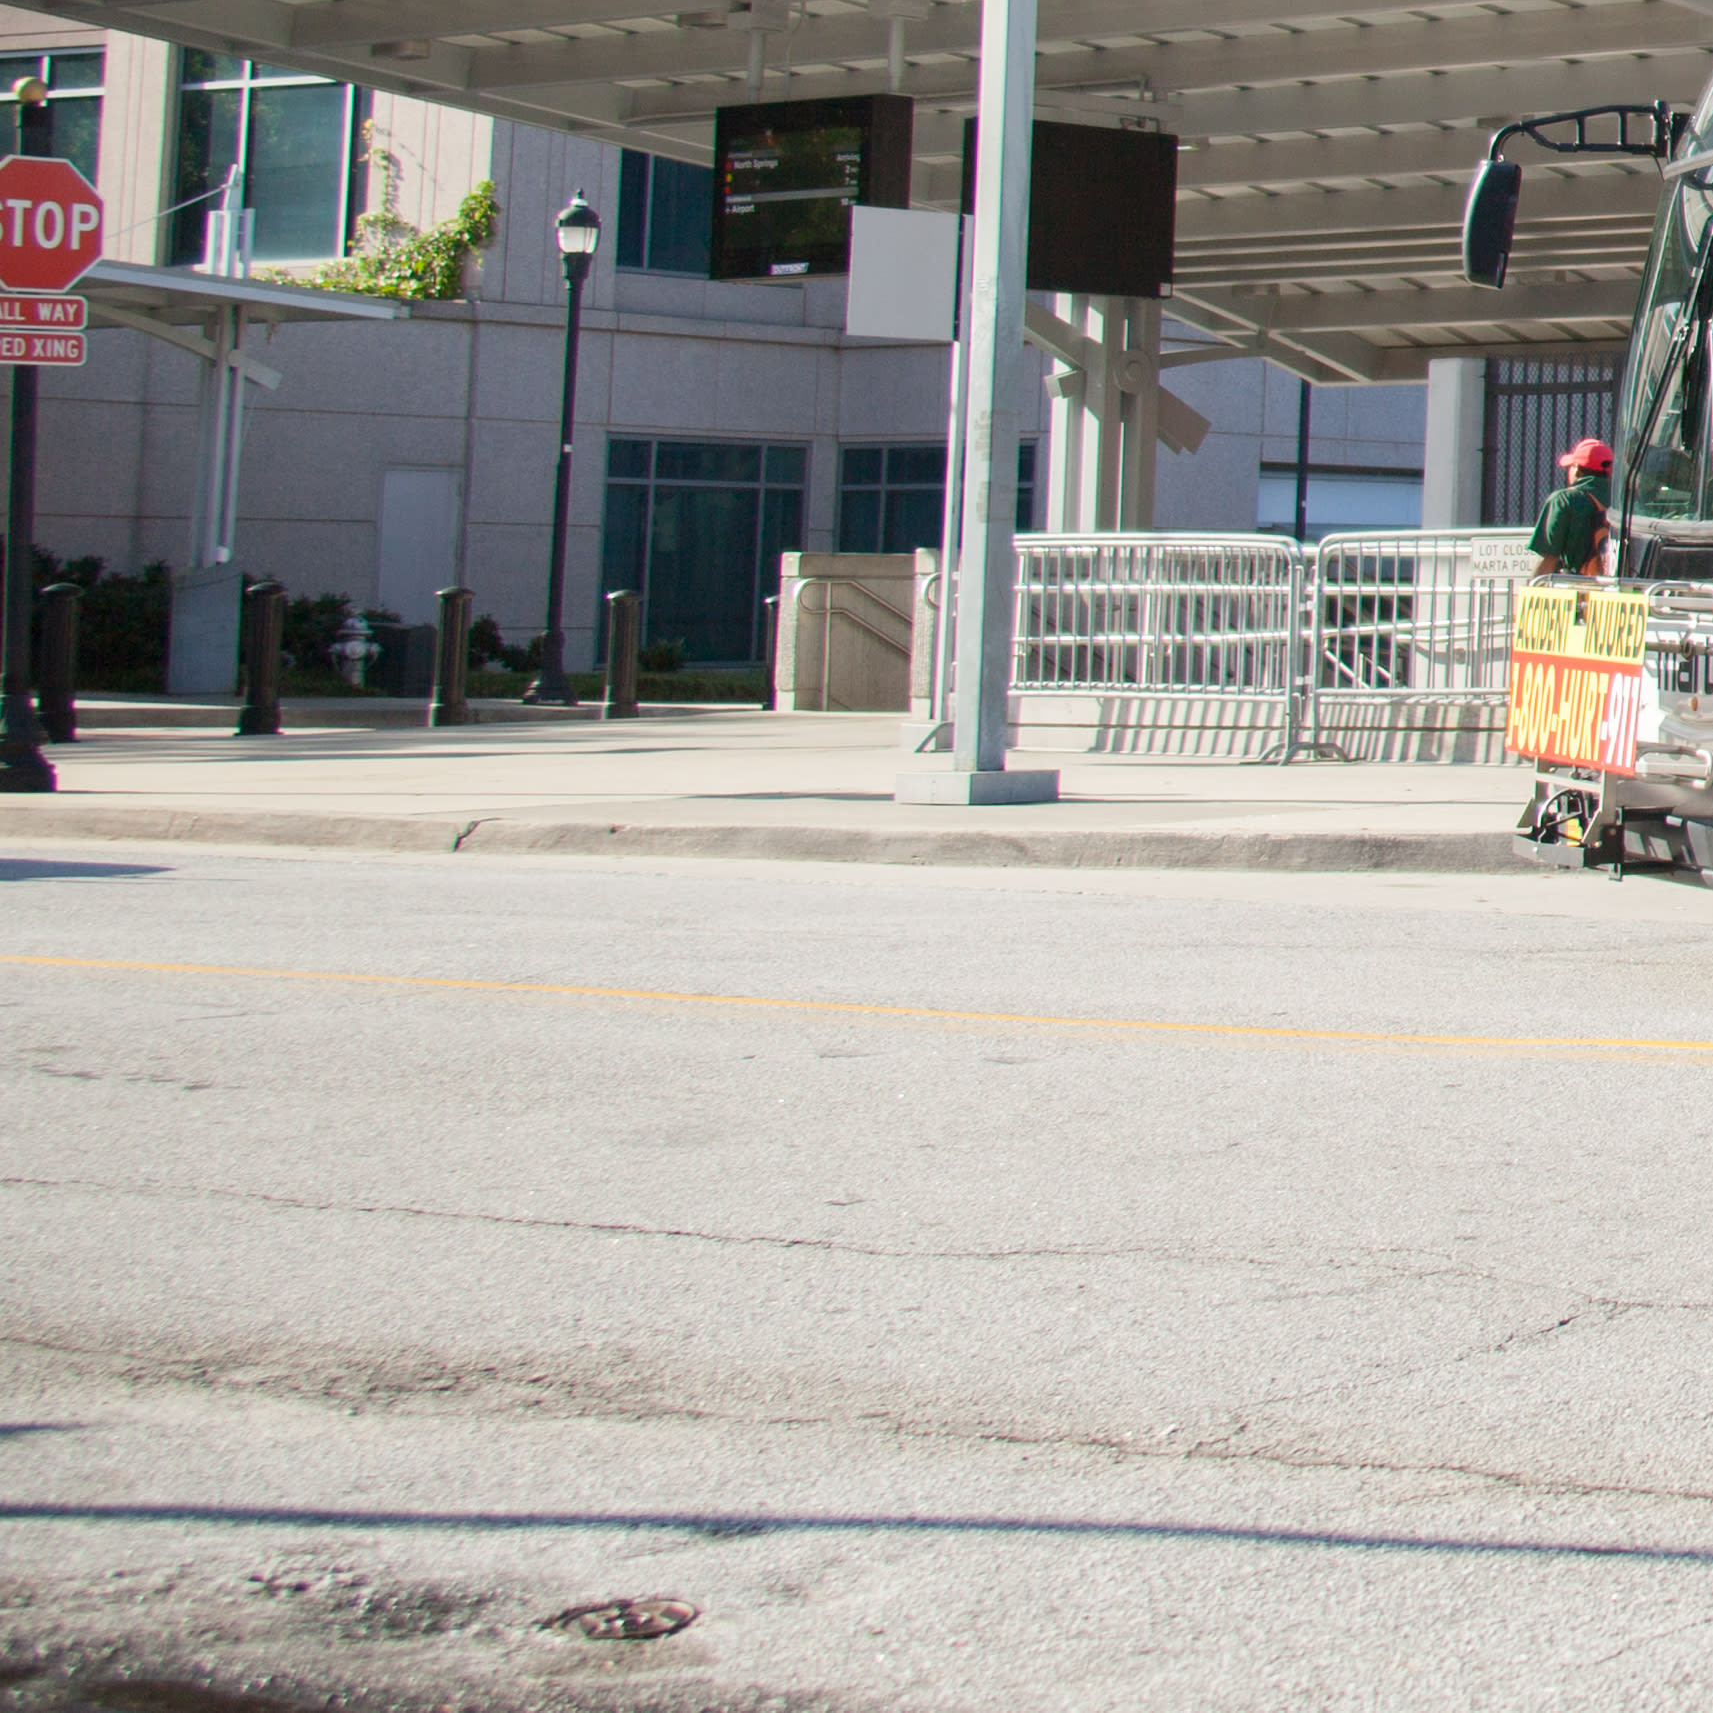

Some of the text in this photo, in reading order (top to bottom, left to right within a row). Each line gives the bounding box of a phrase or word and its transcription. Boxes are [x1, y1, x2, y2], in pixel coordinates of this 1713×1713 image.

[0, 199, 99, 250] TOP
[37, 302, 78, 322] WAY
[0, 337, 79, 358] ED XING
[1479, 543, 1498, 556] LOT
[1473, 559, 1509, 573] MARTA
[1516, 595, 1645, 659] ACCIDENT INJURED
[1506, 662, 1641, 769] 1-800-HURT-911
